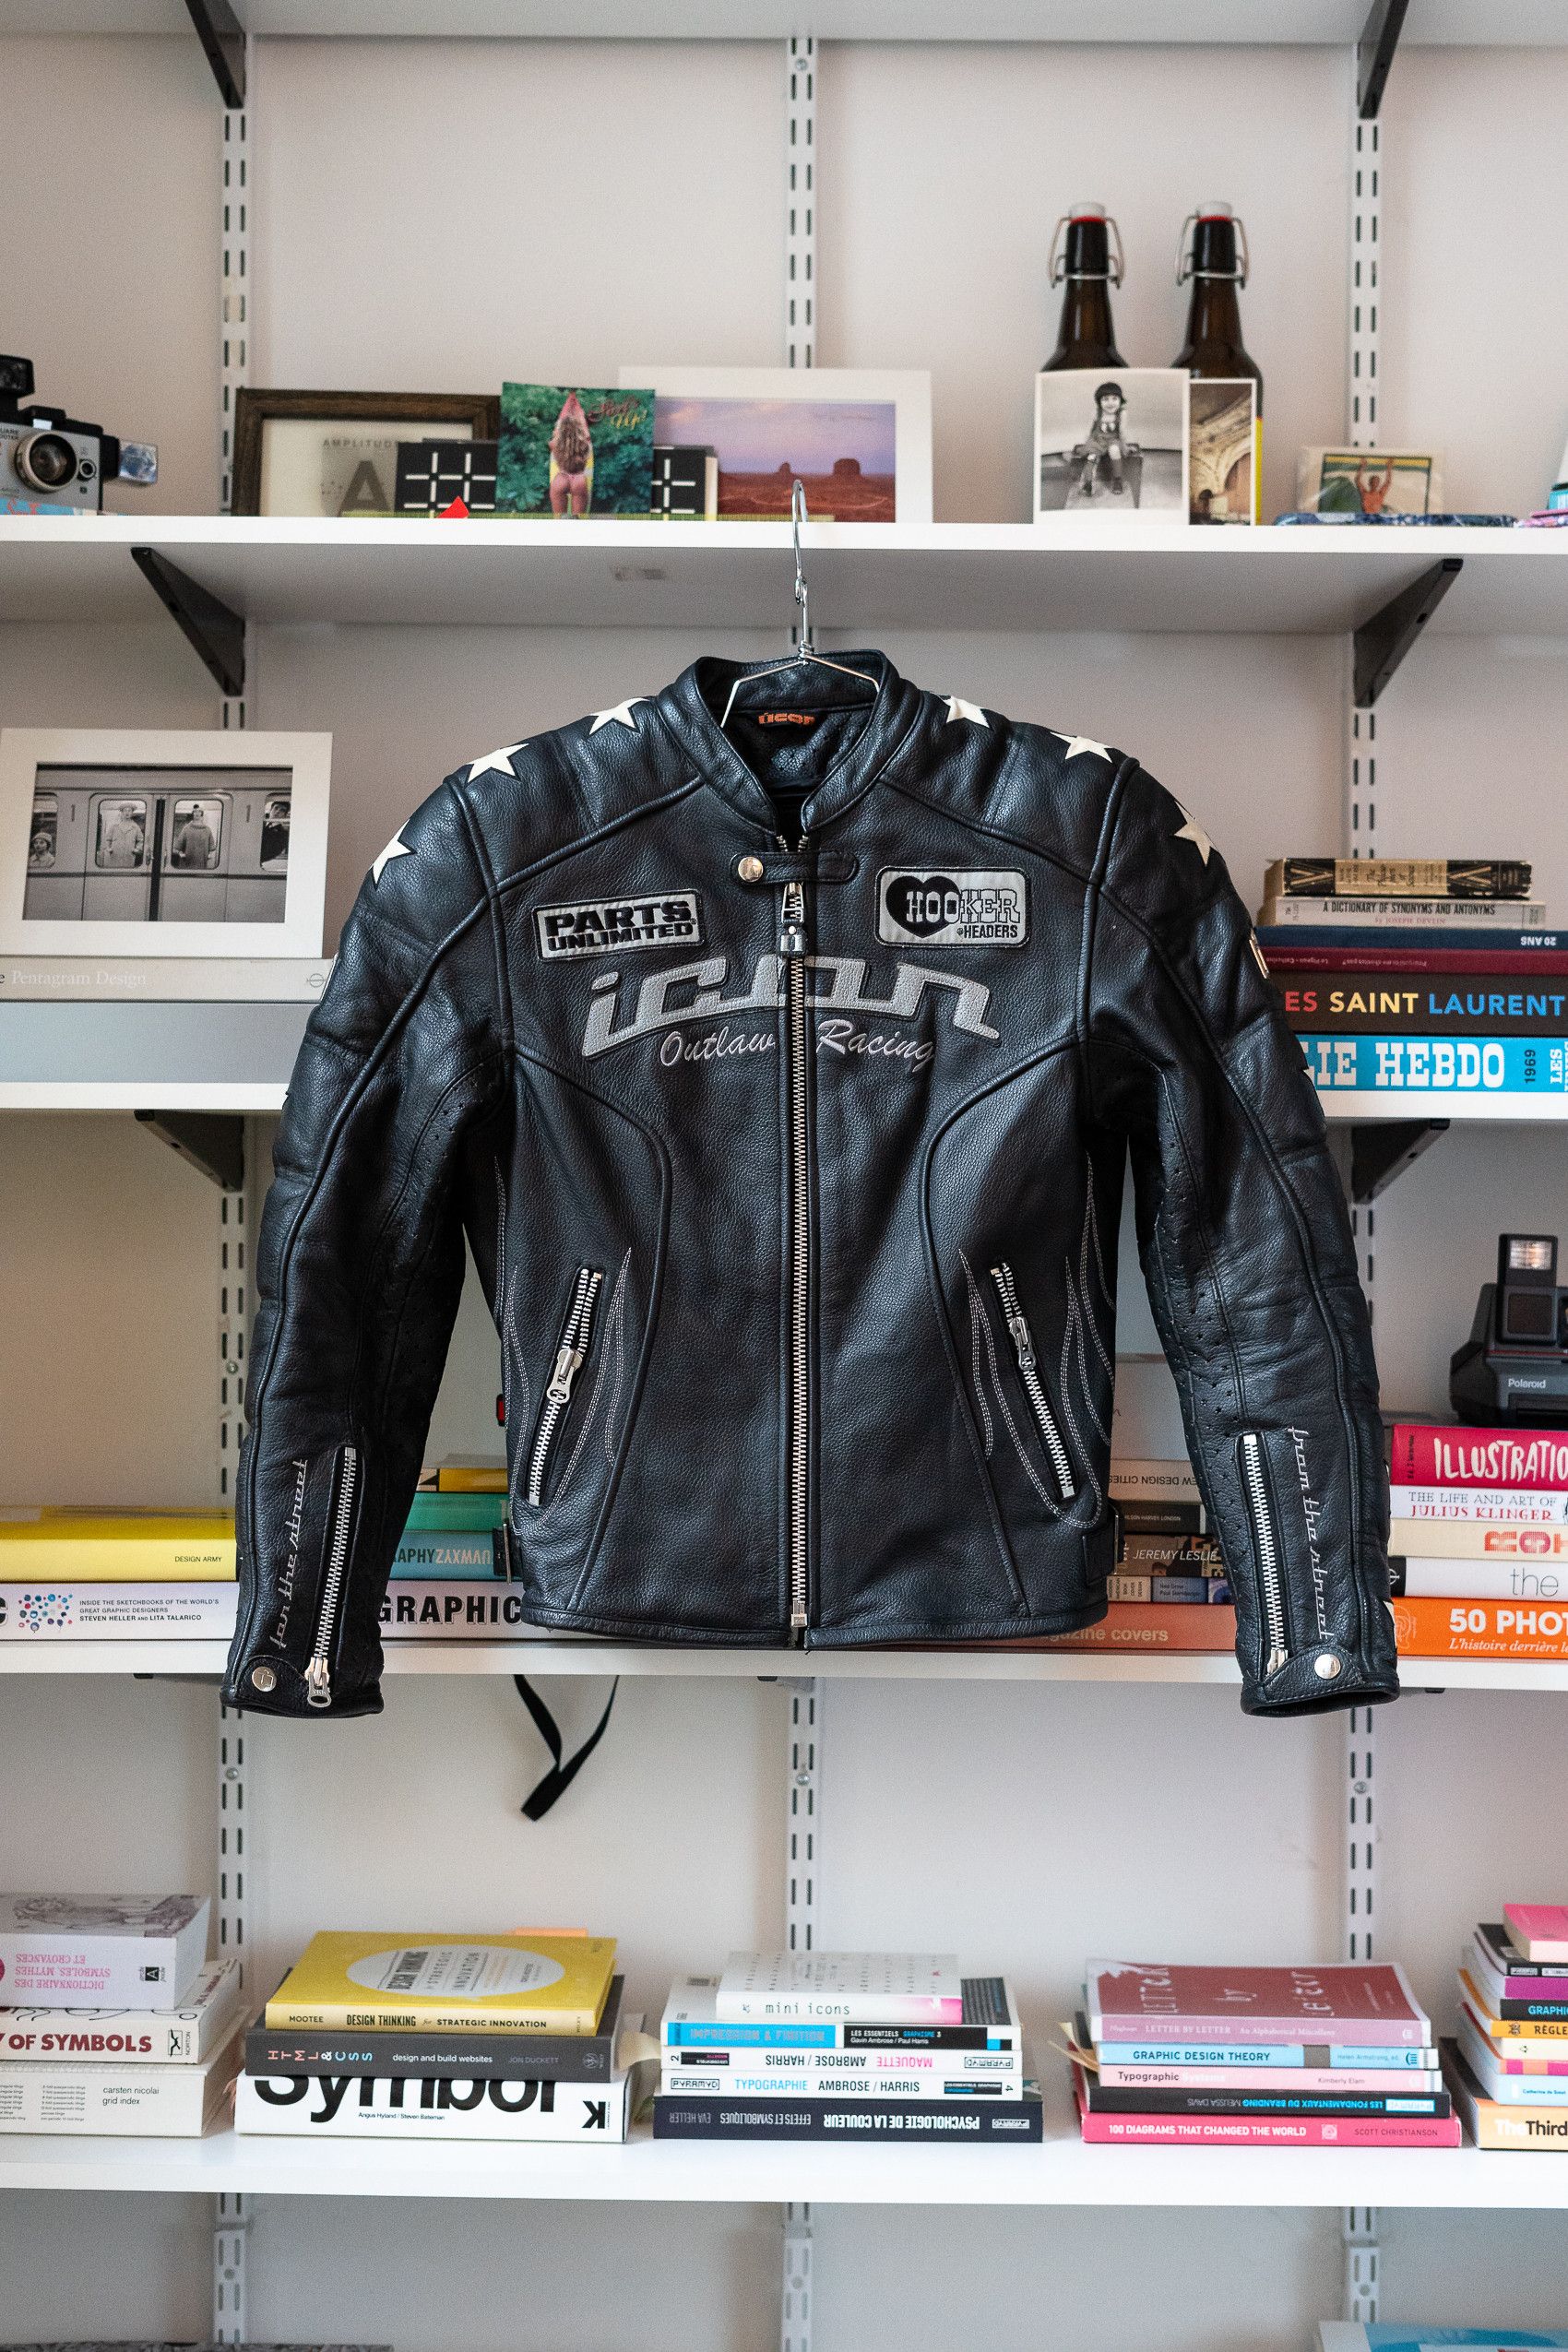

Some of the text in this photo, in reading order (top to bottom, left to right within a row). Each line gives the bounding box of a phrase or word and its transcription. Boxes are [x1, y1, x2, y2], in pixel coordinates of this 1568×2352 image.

[323, 438, 399, 449] AMPLITUD
[904, 889, 1022, 925] HOOKER
[1323, 901, 1496, 916] A DICTIONARY OF SYNONYMS AND ANTONYMS
[544, 899, 695, 940] PARTS
[547, 922, 694, 953] UNLIMITED
[963, 924, 1019, 940] HEADERS
[1520, 935, 1557, 947] 20 ANS
[11, 970, 91, 989] Pentagram
[95, 970, 147, 989] Design
[1285, 991, 1566, 1017] ES SAINT LAURENT
[659, 1019, 935, 1073] Outlaw Racing
[1375, 1041, 1505, 1088] HEBDO
[1524, 1049, 1537, 1084] 1969
[1550, 1049, 1562, 1085] LES
[1507, 1377, 1547, 1389] Polaroid
[1140, 1475, 1180, 1486] DESIGN
[1409, 1491, 1557, 1507] THE LIFE AND ART OF
[1411, 1506, 1553, 1521] JULIUS KLINGER
[1287, 1426, 1335, 1640] from the street
[269, 1458, 308, 1650] for the street
[1133, 1550, 1218, 1561] JEREMY LESLIE
[1510, 1567, 1560, 1598] the
[377, 1595, 522, 1624] GRAPHIC
[1449, 1608, 1487, 1634] 50
[1111, 1628, 1169, 1642] covers
[1449, 1638, 1559, 1653] L'histoire derrière
[16, 1954, 86, 1965] ET CROYANCES
[15, 1966, 54, 1977] MYTHES
[14, 1979, 105, 1990] DICTIONNAIRE DES
[765, 2002, 850, 2016] mini icons
[289, 2014, 547, 2028] MOOTEE DESIGN THINKING STRATEGIC INNOVATION
[690, 2029, 826, 2042] IMPRESSION FINITION
[1145, 2025, 1181, 2034] LETTER
[1194, 2025, 1231, 2035] LETTER
[8, 2034, 152, 2053] OF SYMBOLS
[392, 2052, 493, 2063] design and build websites
[526, 2056, 560, 2064] DUCKETT
[766, 2055, 933, 2068] MAQUETTE AMBROSE HARRIS
[1133, 2050, 1271, 2061] GRAPHIC DESIGN THEORY
[1117, 2071, 1180, 2082] Typographic
[1318, 2077, 1347, 2085] Kimberly
[102, 2086, 160, 2095] carsten nicolai
[734, 2079, 921, 2093] TYPOGRAPHIE AMBROSE HARRIS
[102, 2097, 140, 2106] grid index
[1187, 2098, 1383, 2108] LES FONDAMENTAUX DU BRANDING MELISSA DAVIS
[669, 2111, 711, 2123] EVA HELLER
[719, 2112, 812, 2125] EFFETS ET SYMBOLIQUES
[824, 2114, 980, 2130] PSYCHOLOGIE DE LA COULEUR
[1109, 2125, 1307, 2137] 100 DIAGRAMS THAT CHANGED THE WORLD
[1354, 2129, 1439, 2138] SCOTT CHRISTIANSON
[1526, 2120, 1568, 2137] Third
